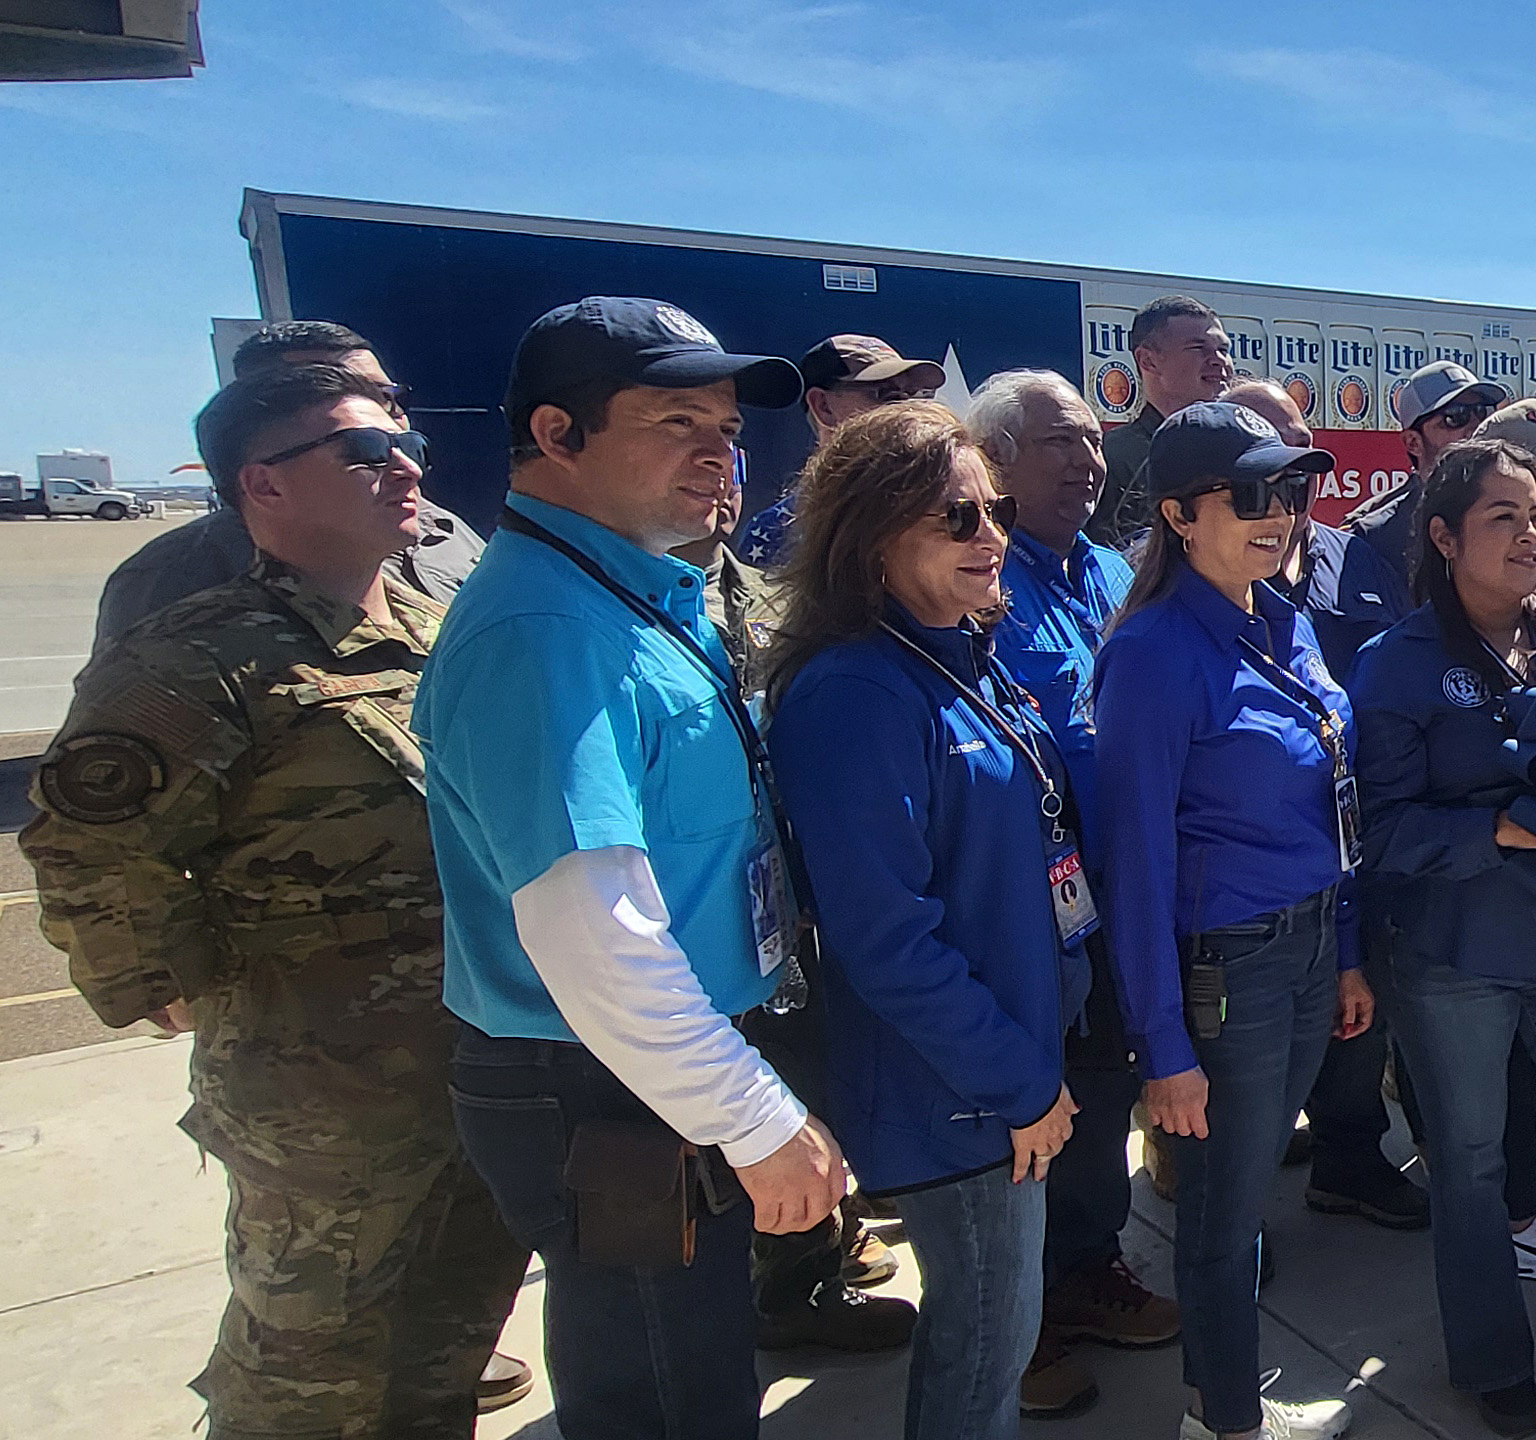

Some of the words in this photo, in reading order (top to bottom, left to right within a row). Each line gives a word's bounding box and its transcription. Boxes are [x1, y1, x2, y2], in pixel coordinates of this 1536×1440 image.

[1088, 321, 1134, 359] Lit
[1230, 333, 1264, 364] ite
[1275, 335, 1320, 370] Lite
[1332, 339, 1373, 373] Lite
[1384, 343, 1424, 376] Lite
[1483, 350, 1519, 380] Lite
[1320, 470, 1361, 498] AS
